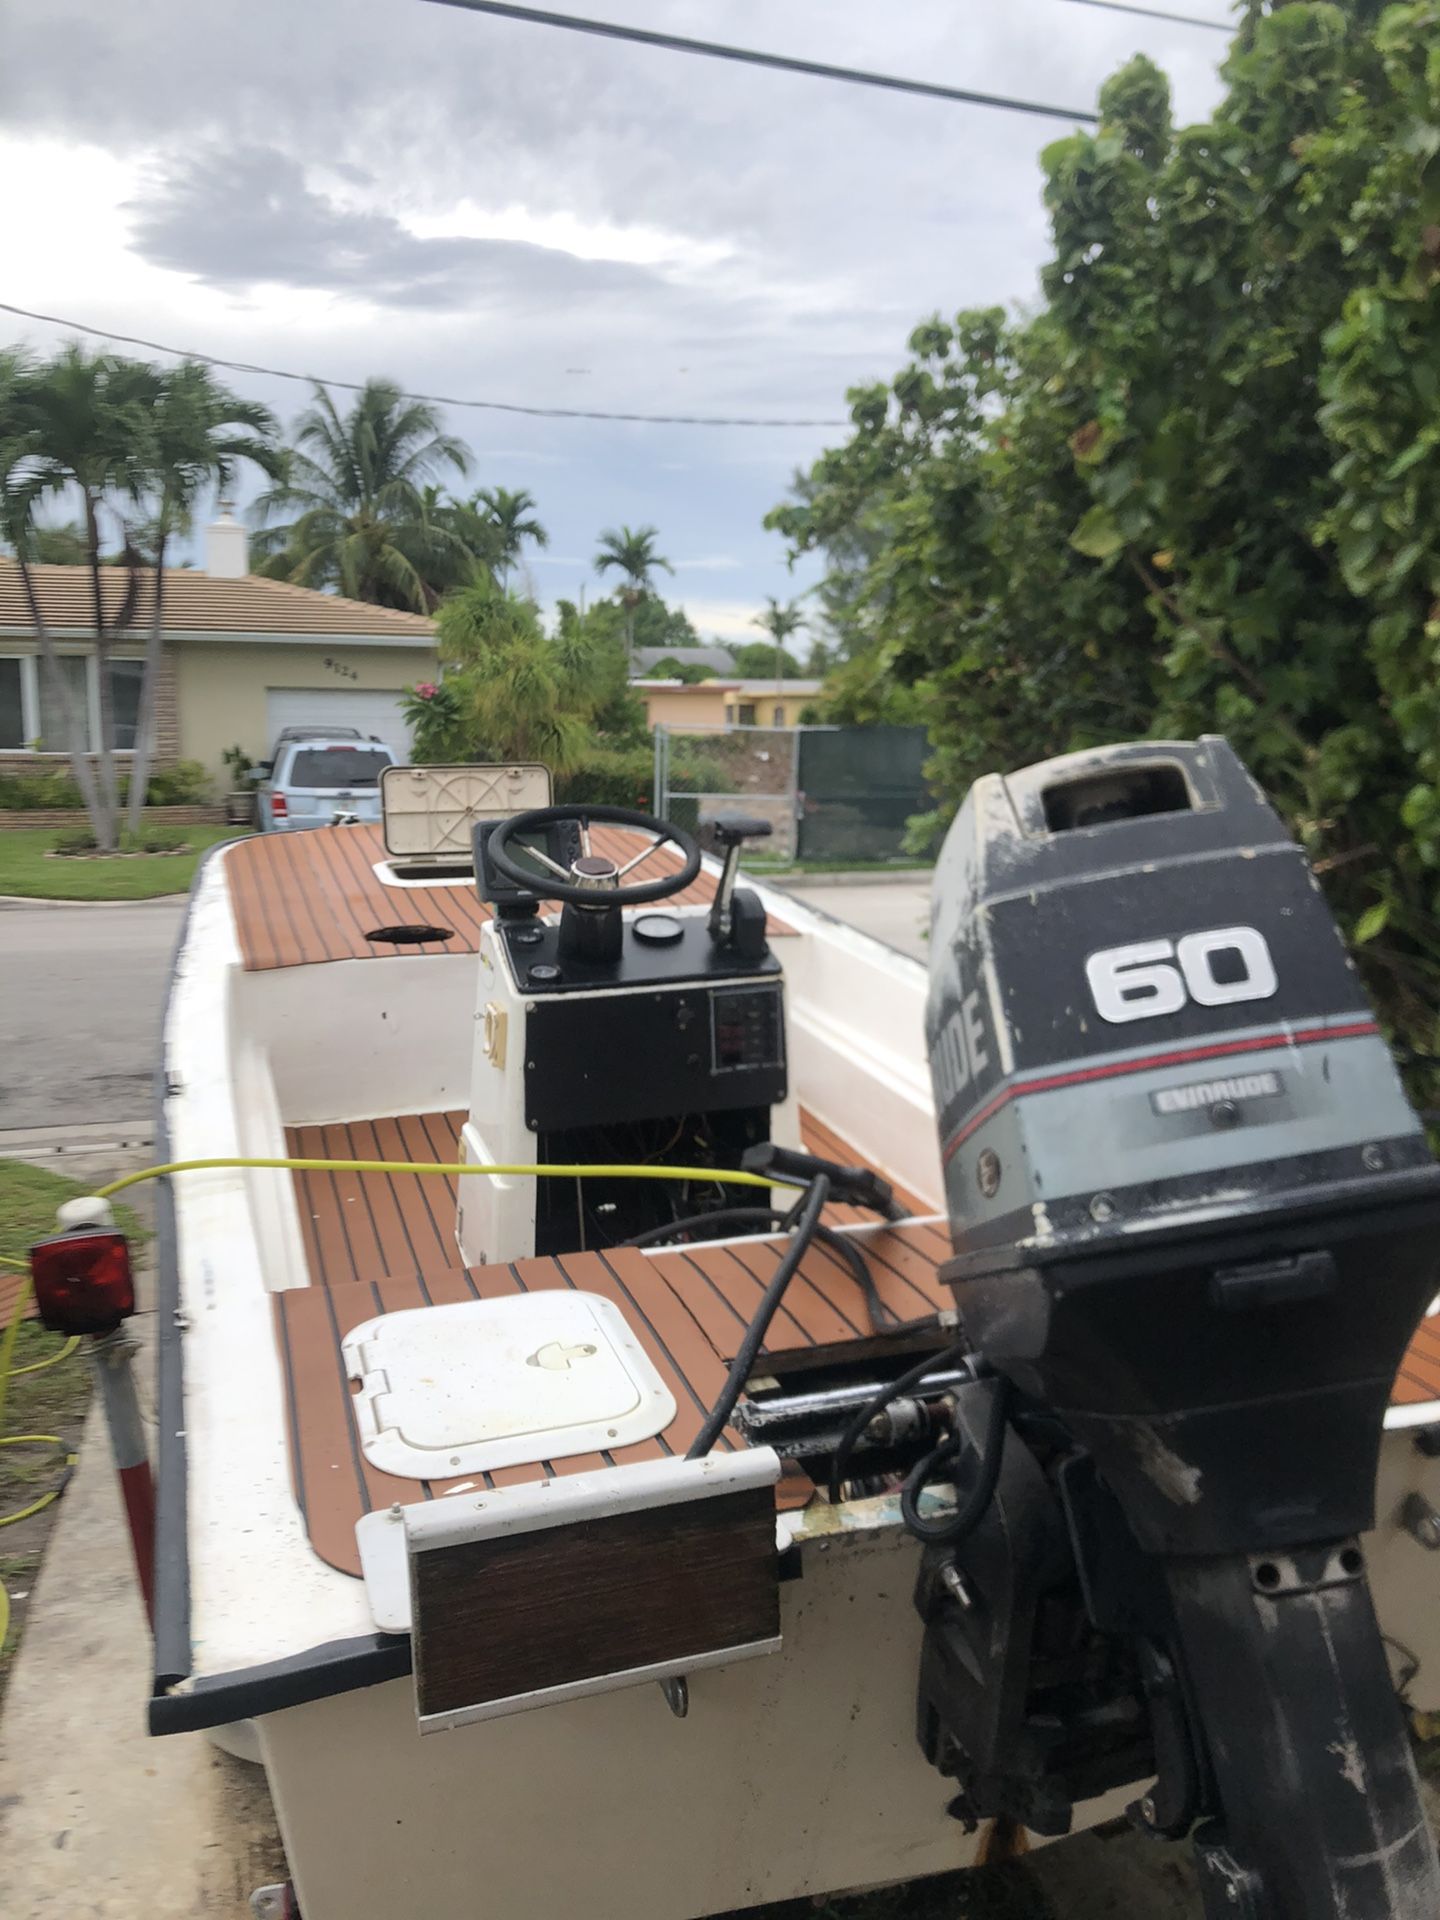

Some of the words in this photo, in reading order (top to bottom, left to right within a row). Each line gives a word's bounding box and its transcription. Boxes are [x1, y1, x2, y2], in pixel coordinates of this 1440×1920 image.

[1086, 926, 1279, 1023] 60
[932, 989, 988, 1110] UDE
[1156, 1072, 1278, 1113] EVINRUDE
